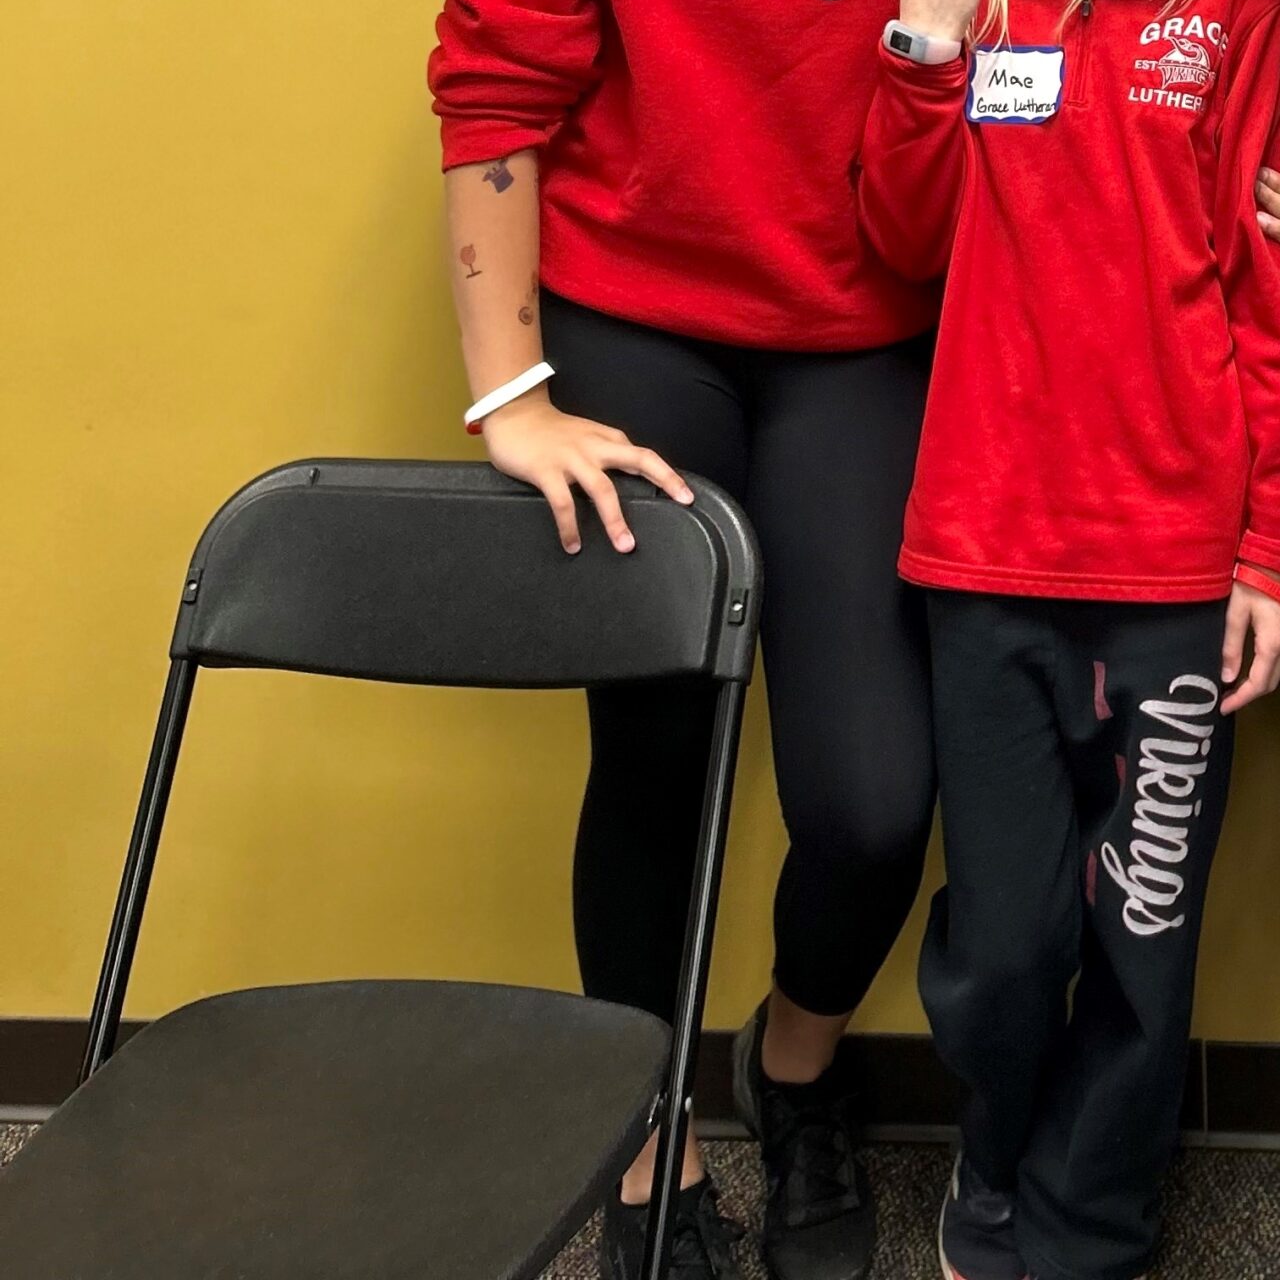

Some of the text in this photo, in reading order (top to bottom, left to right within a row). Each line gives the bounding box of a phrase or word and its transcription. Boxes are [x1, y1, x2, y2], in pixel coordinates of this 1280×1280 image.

[987, 68, 1034, 89] Mae
[976, 96, 1009, 113] Grace
[1101, 674, 1219, 936] Vikings
